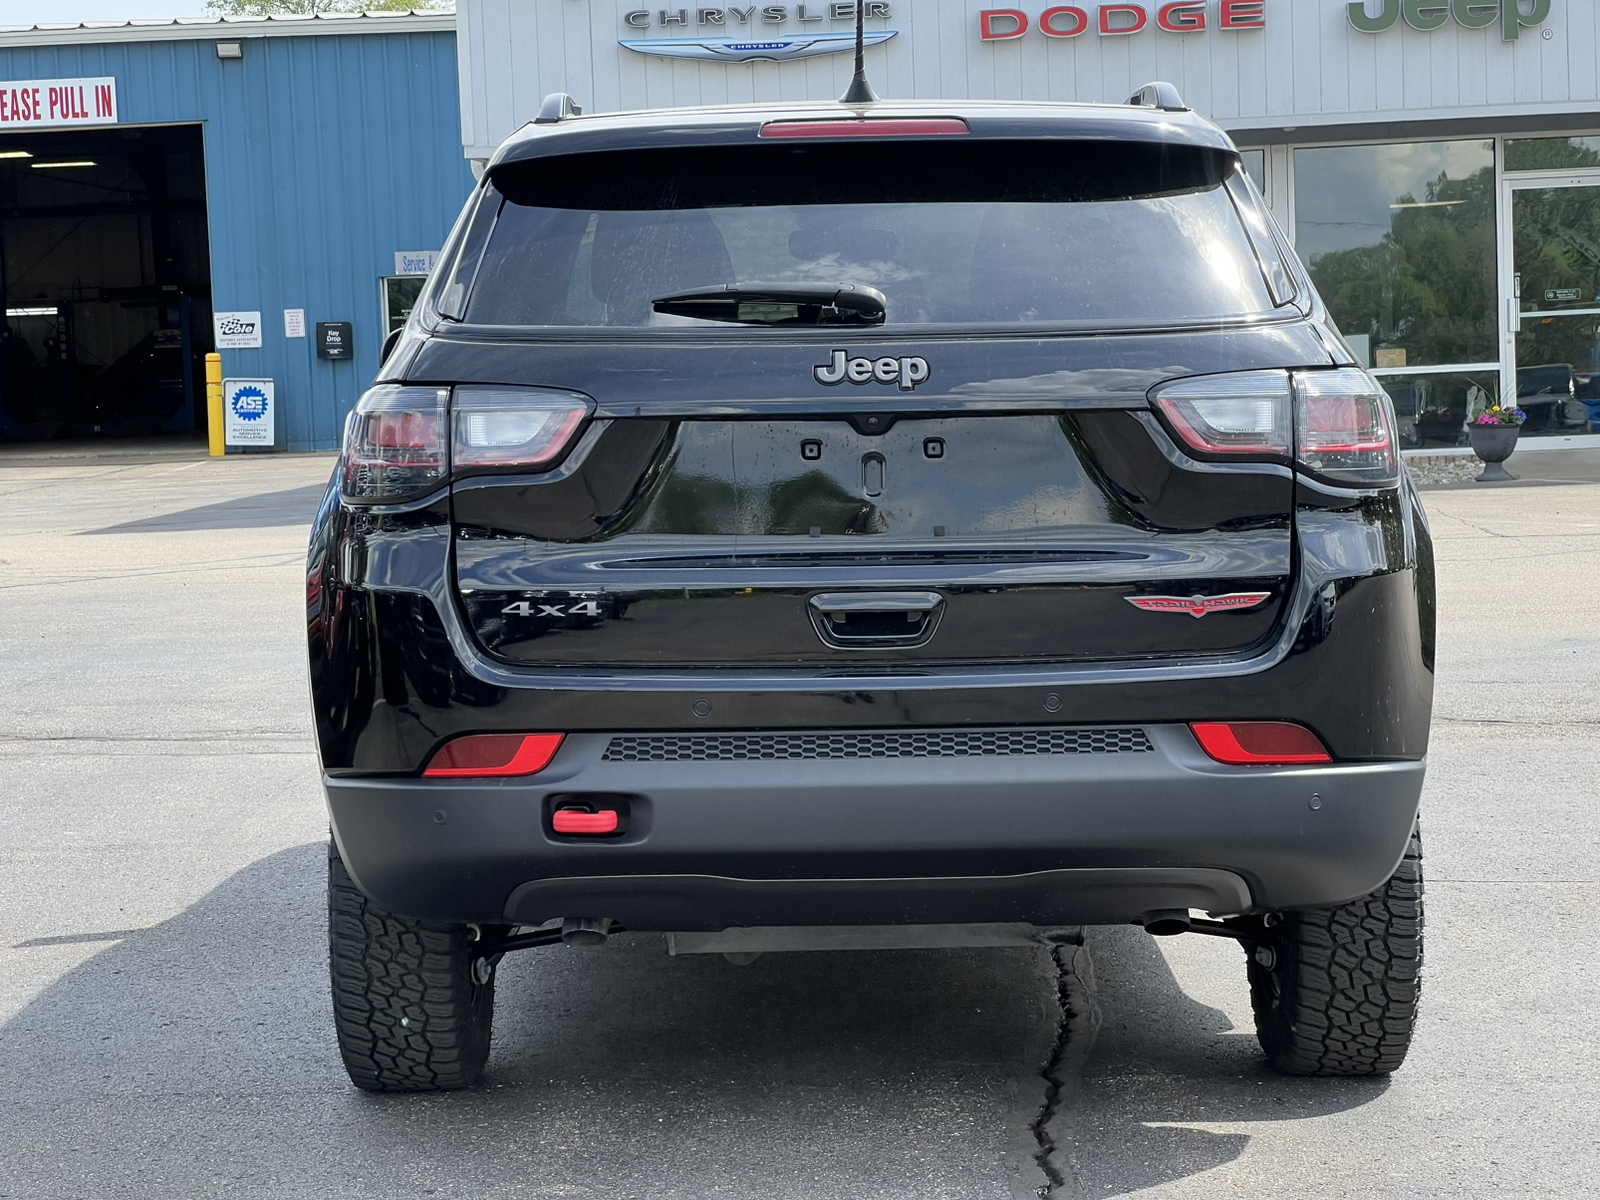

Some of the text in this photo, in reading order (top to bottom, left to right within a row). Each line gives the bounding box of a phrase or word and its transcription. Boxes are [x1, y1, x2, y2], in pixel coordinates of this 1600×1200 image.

[624, 2, 892, 28] CHRYSLER
[979, 0, 1266, 42] DODGE
[1347, 0, 1551, 42] Jeep
[730, 42, 785, 50] CHRYSLER
[49, 86, 89, 120] PULL
[95, 85, 113, 118] IN
[403, 255, 426, 272] Service
[224, 324, 254, 334] Cole
[815, 350, 930, 390] Jeep
[235, 396, 263, 409] ASE
[501, 601, 603, 617] 4x4
